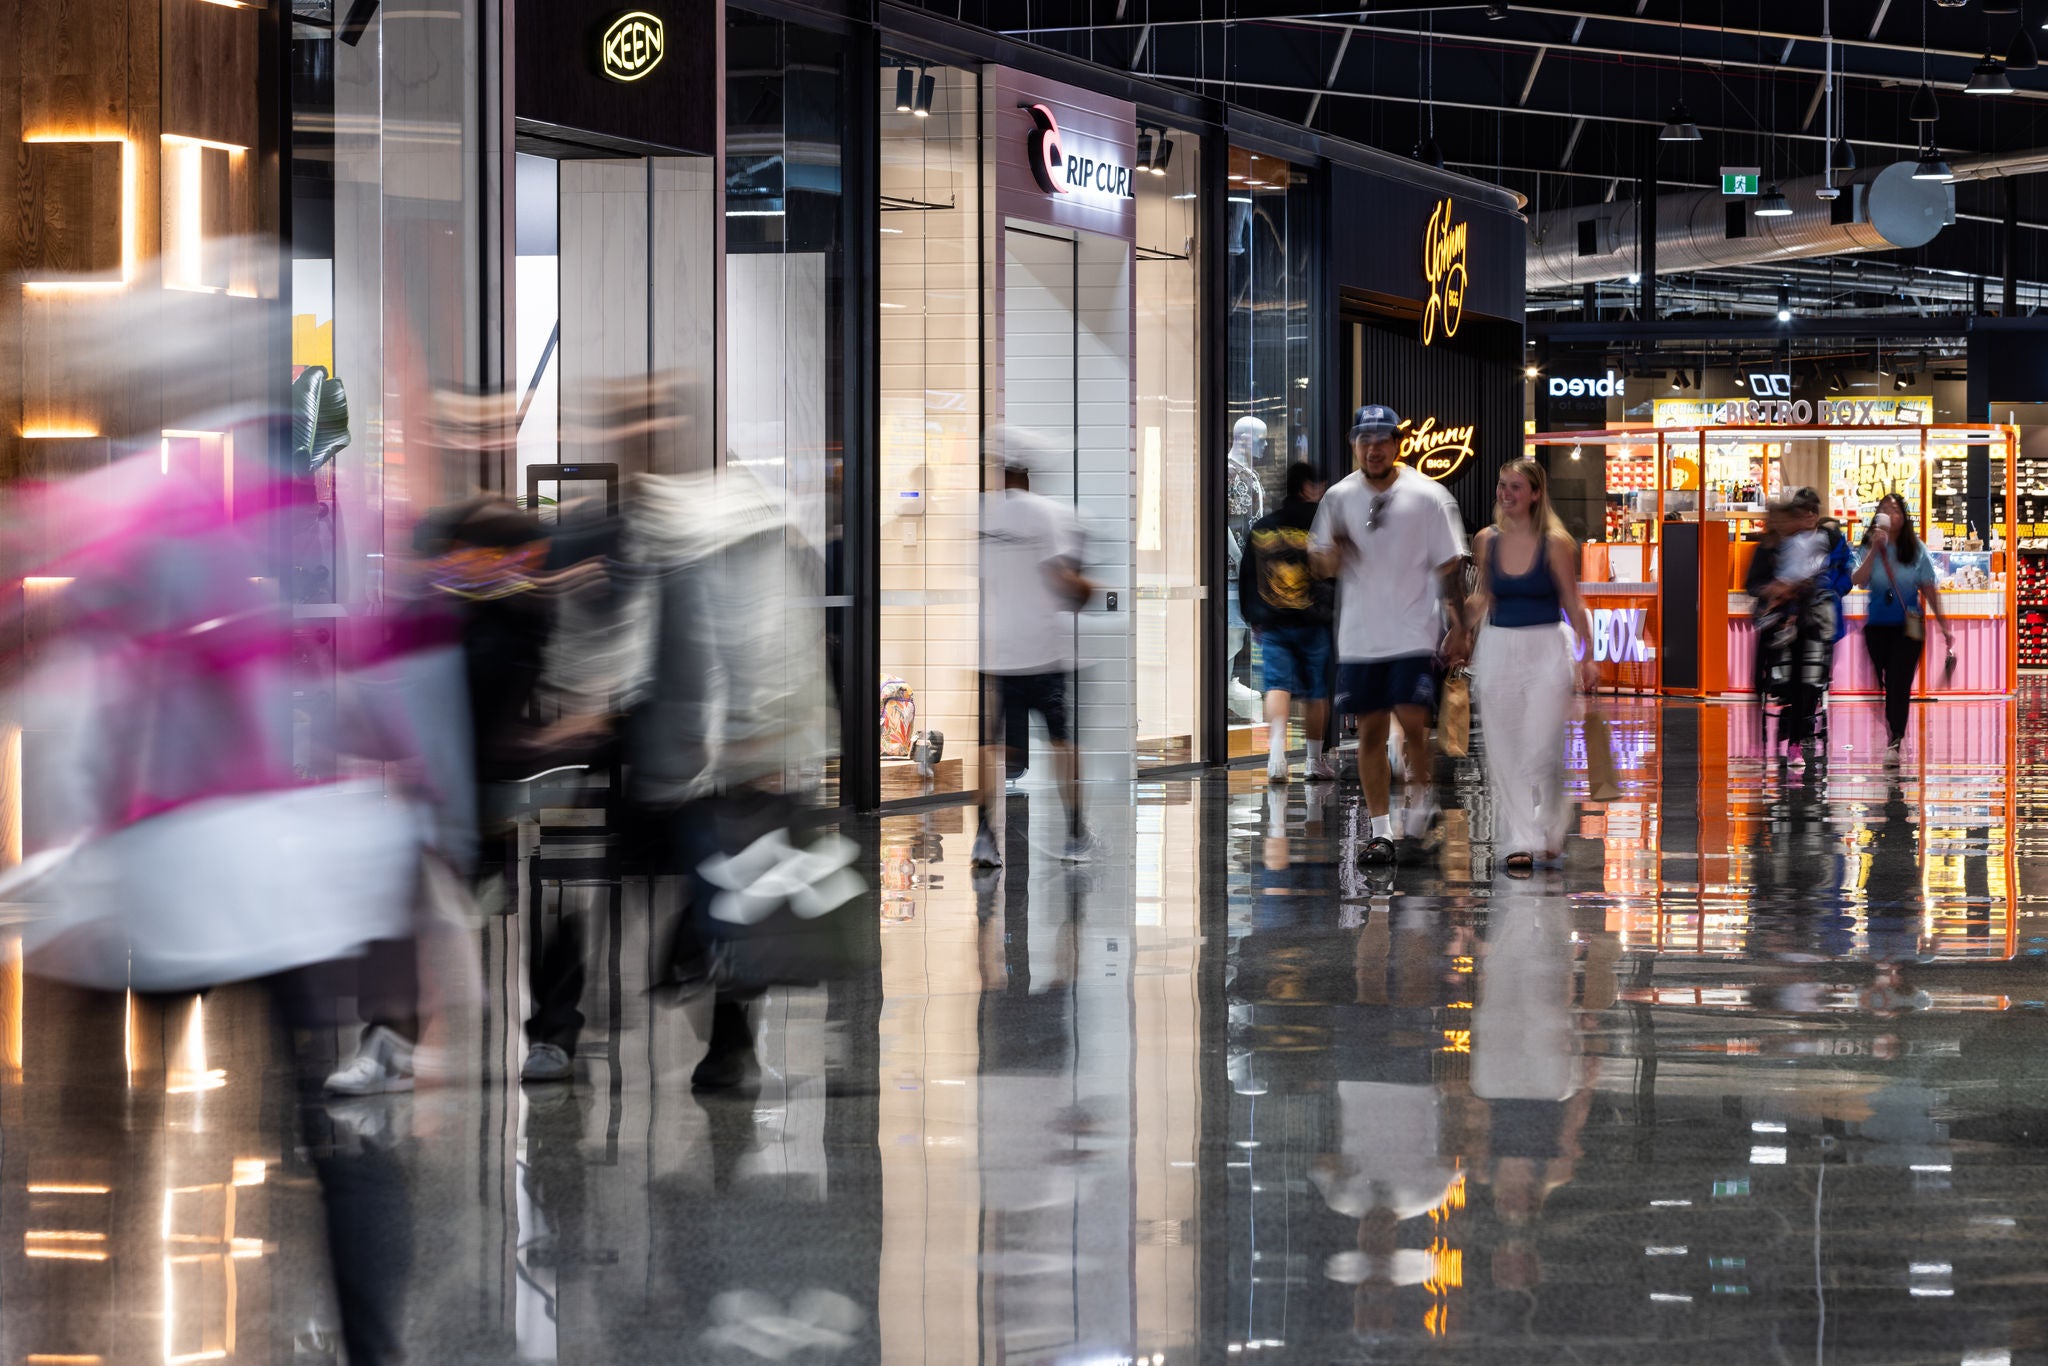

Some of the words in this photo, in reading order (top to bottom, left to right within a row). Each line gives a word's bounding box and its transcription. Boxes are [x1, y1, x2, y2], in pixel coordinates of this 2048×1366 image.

[606, 22, 661, 70] KEEN
[1067, 155, 1094, 187] RIP
[1096, 163, 1135, 199] CURL
[1424, 198, 1468, 346] Johnny
[1726, 400, 1813, 425] BISTRO
[1427, 459, 1451, 469] BIGG
[1845, 460, 1914, 485] BRAND
